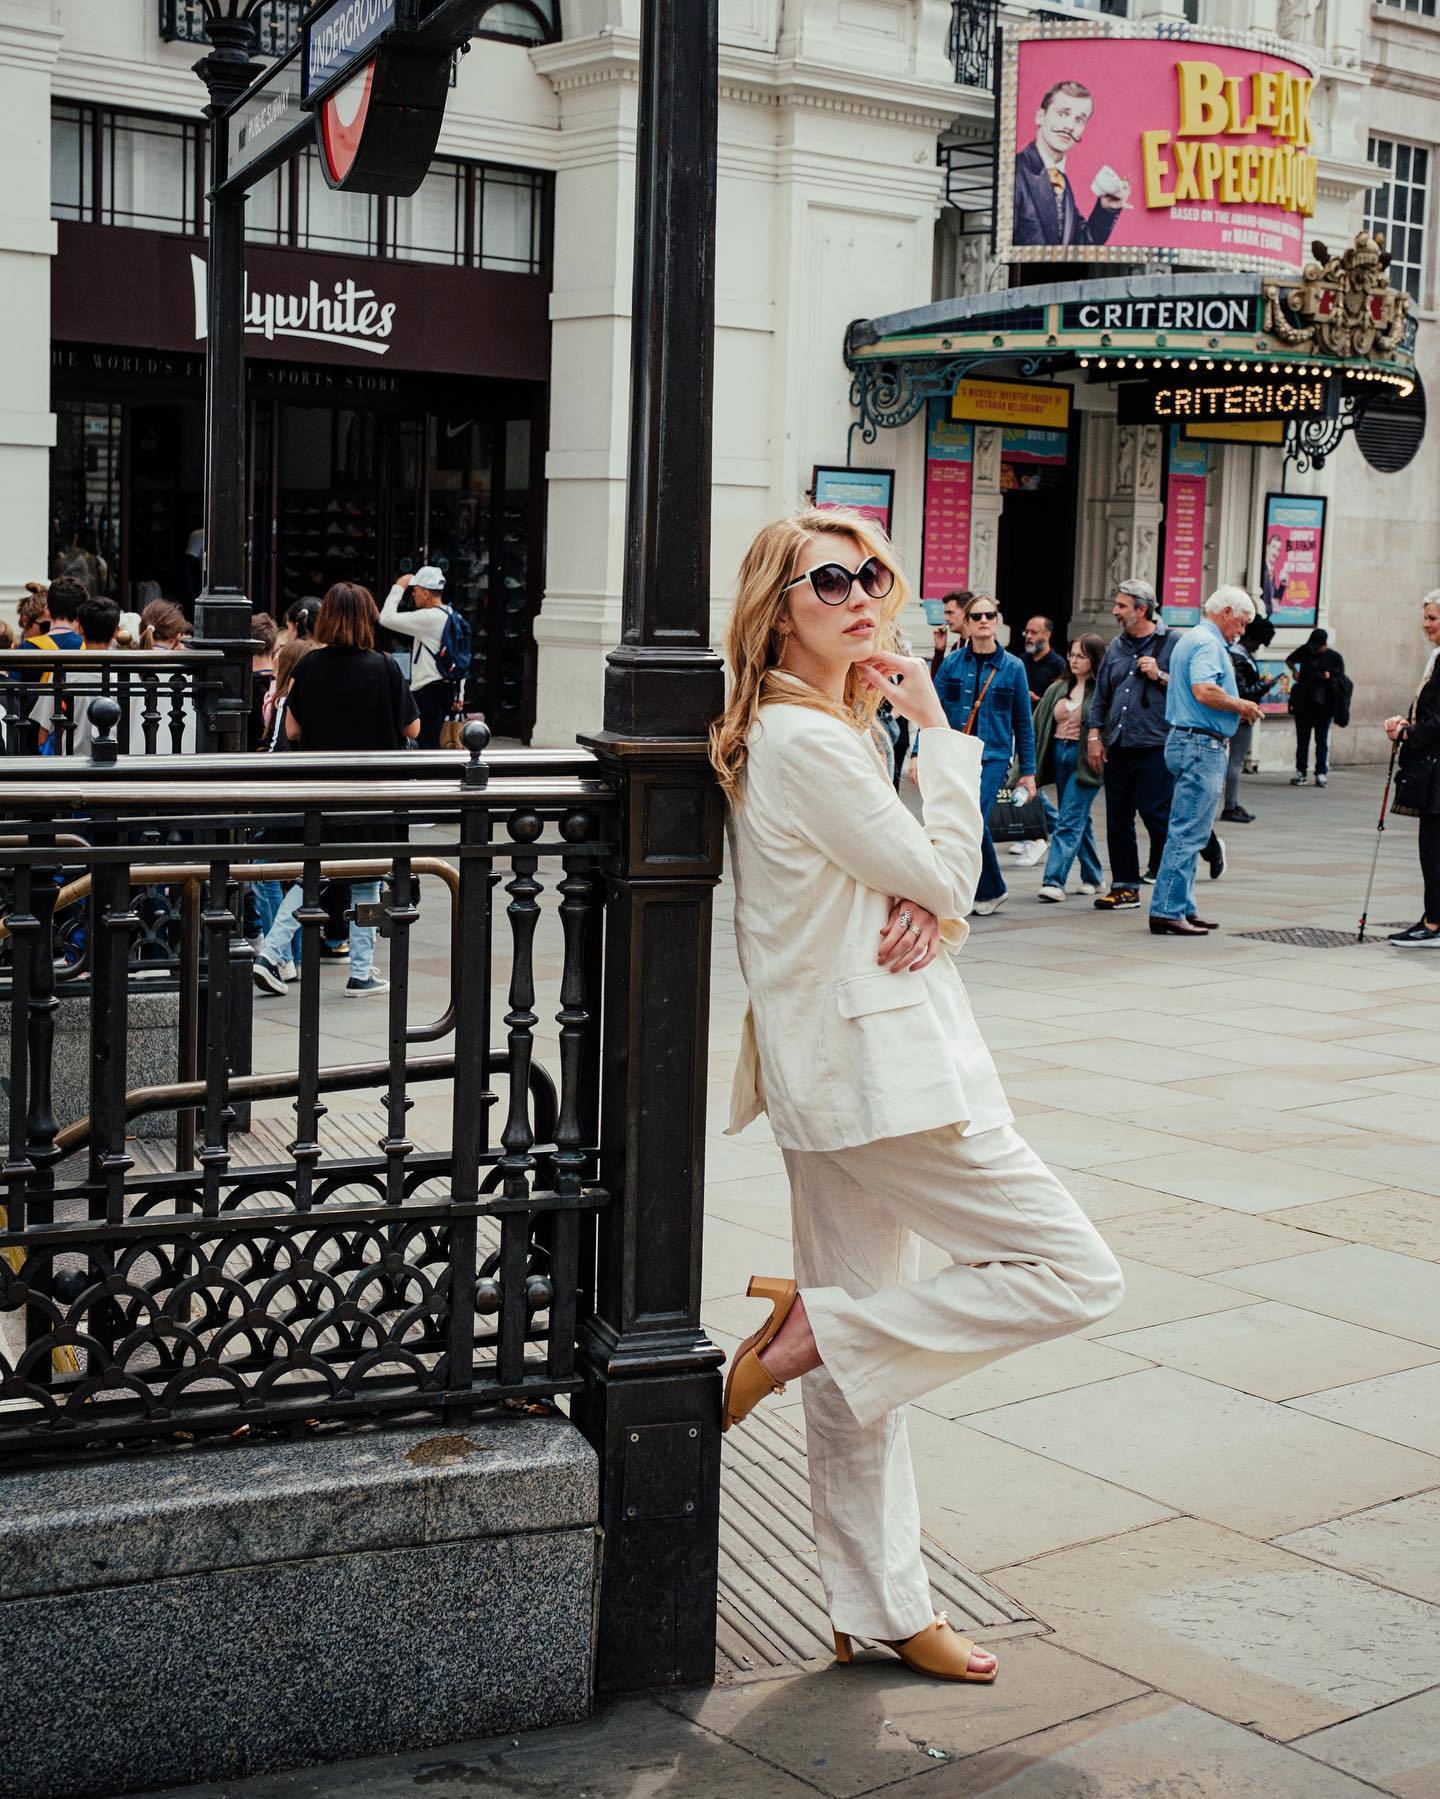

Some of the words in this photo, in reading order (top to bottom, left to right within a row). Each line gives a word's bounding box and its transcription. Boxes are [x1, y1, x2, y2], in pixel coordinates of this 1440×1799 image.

[309, 0, 393, 78] UNDERGROU
[266, 86, 290, 126] SUBWAY
[1175, 61, 1313, 147] BLEAK
[1170, 207, 1199, 221] BASED
[1201, 209, 1213, 222] ON
[1215, 211, 1229, 224] THE
[1221, 229, 1233, 243] BY
[1233, 228, 1259, 247] MARK
[1078, 299, 1249, 329] CRITERION
[52, 351, 77, 366] HE
[267, 371, 333, 386] SPORTS
[346, 375, 399, 392] STORE
[1154, 382, 1322, 415] CRITERION
